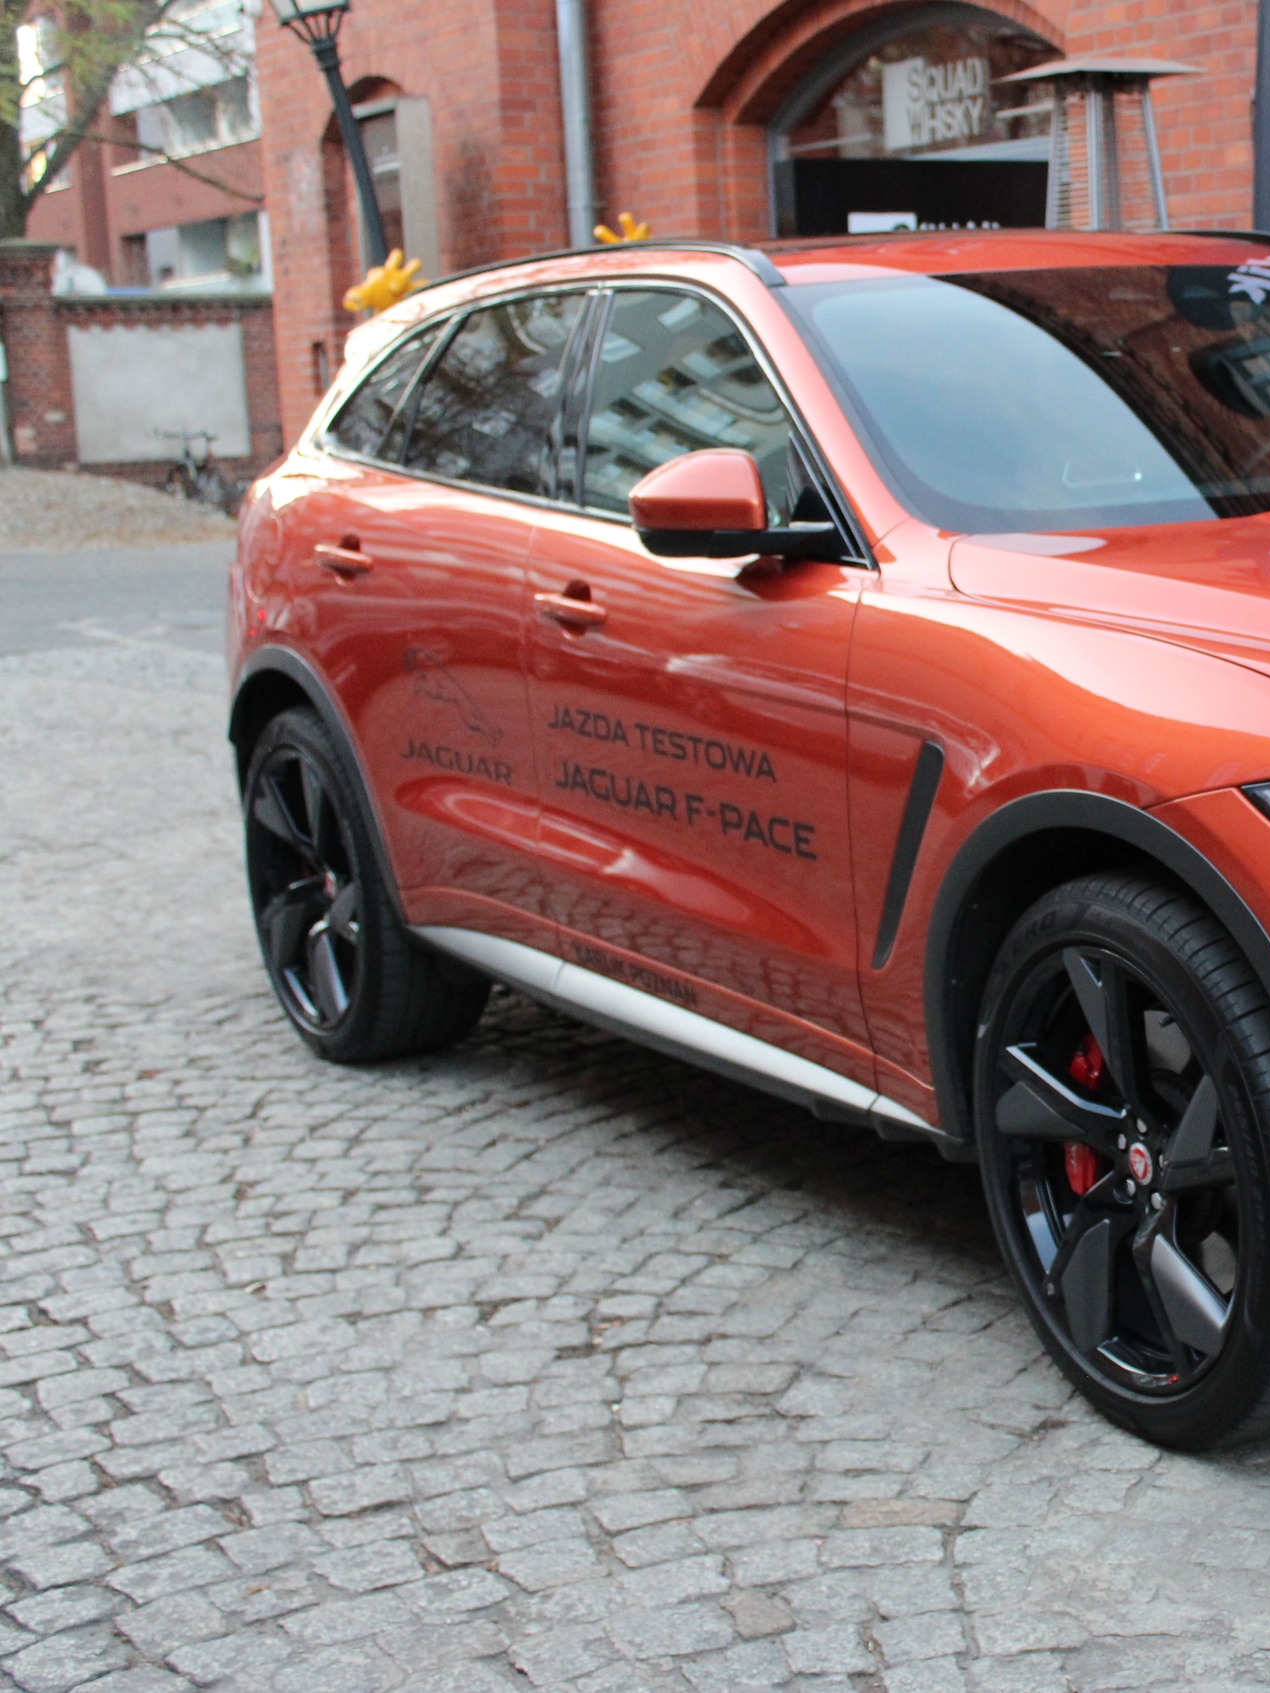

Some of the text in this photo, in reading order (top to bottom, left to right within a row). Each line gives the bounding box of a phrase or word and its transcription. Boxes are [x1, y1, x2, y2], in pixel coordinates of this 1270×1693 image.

[400, 739, 512, 785] JAGUAR
[548, 705, 777, 783] JAZDA TESTOWA
[555, 760, 818, 861] JAGUAR F-PACE
